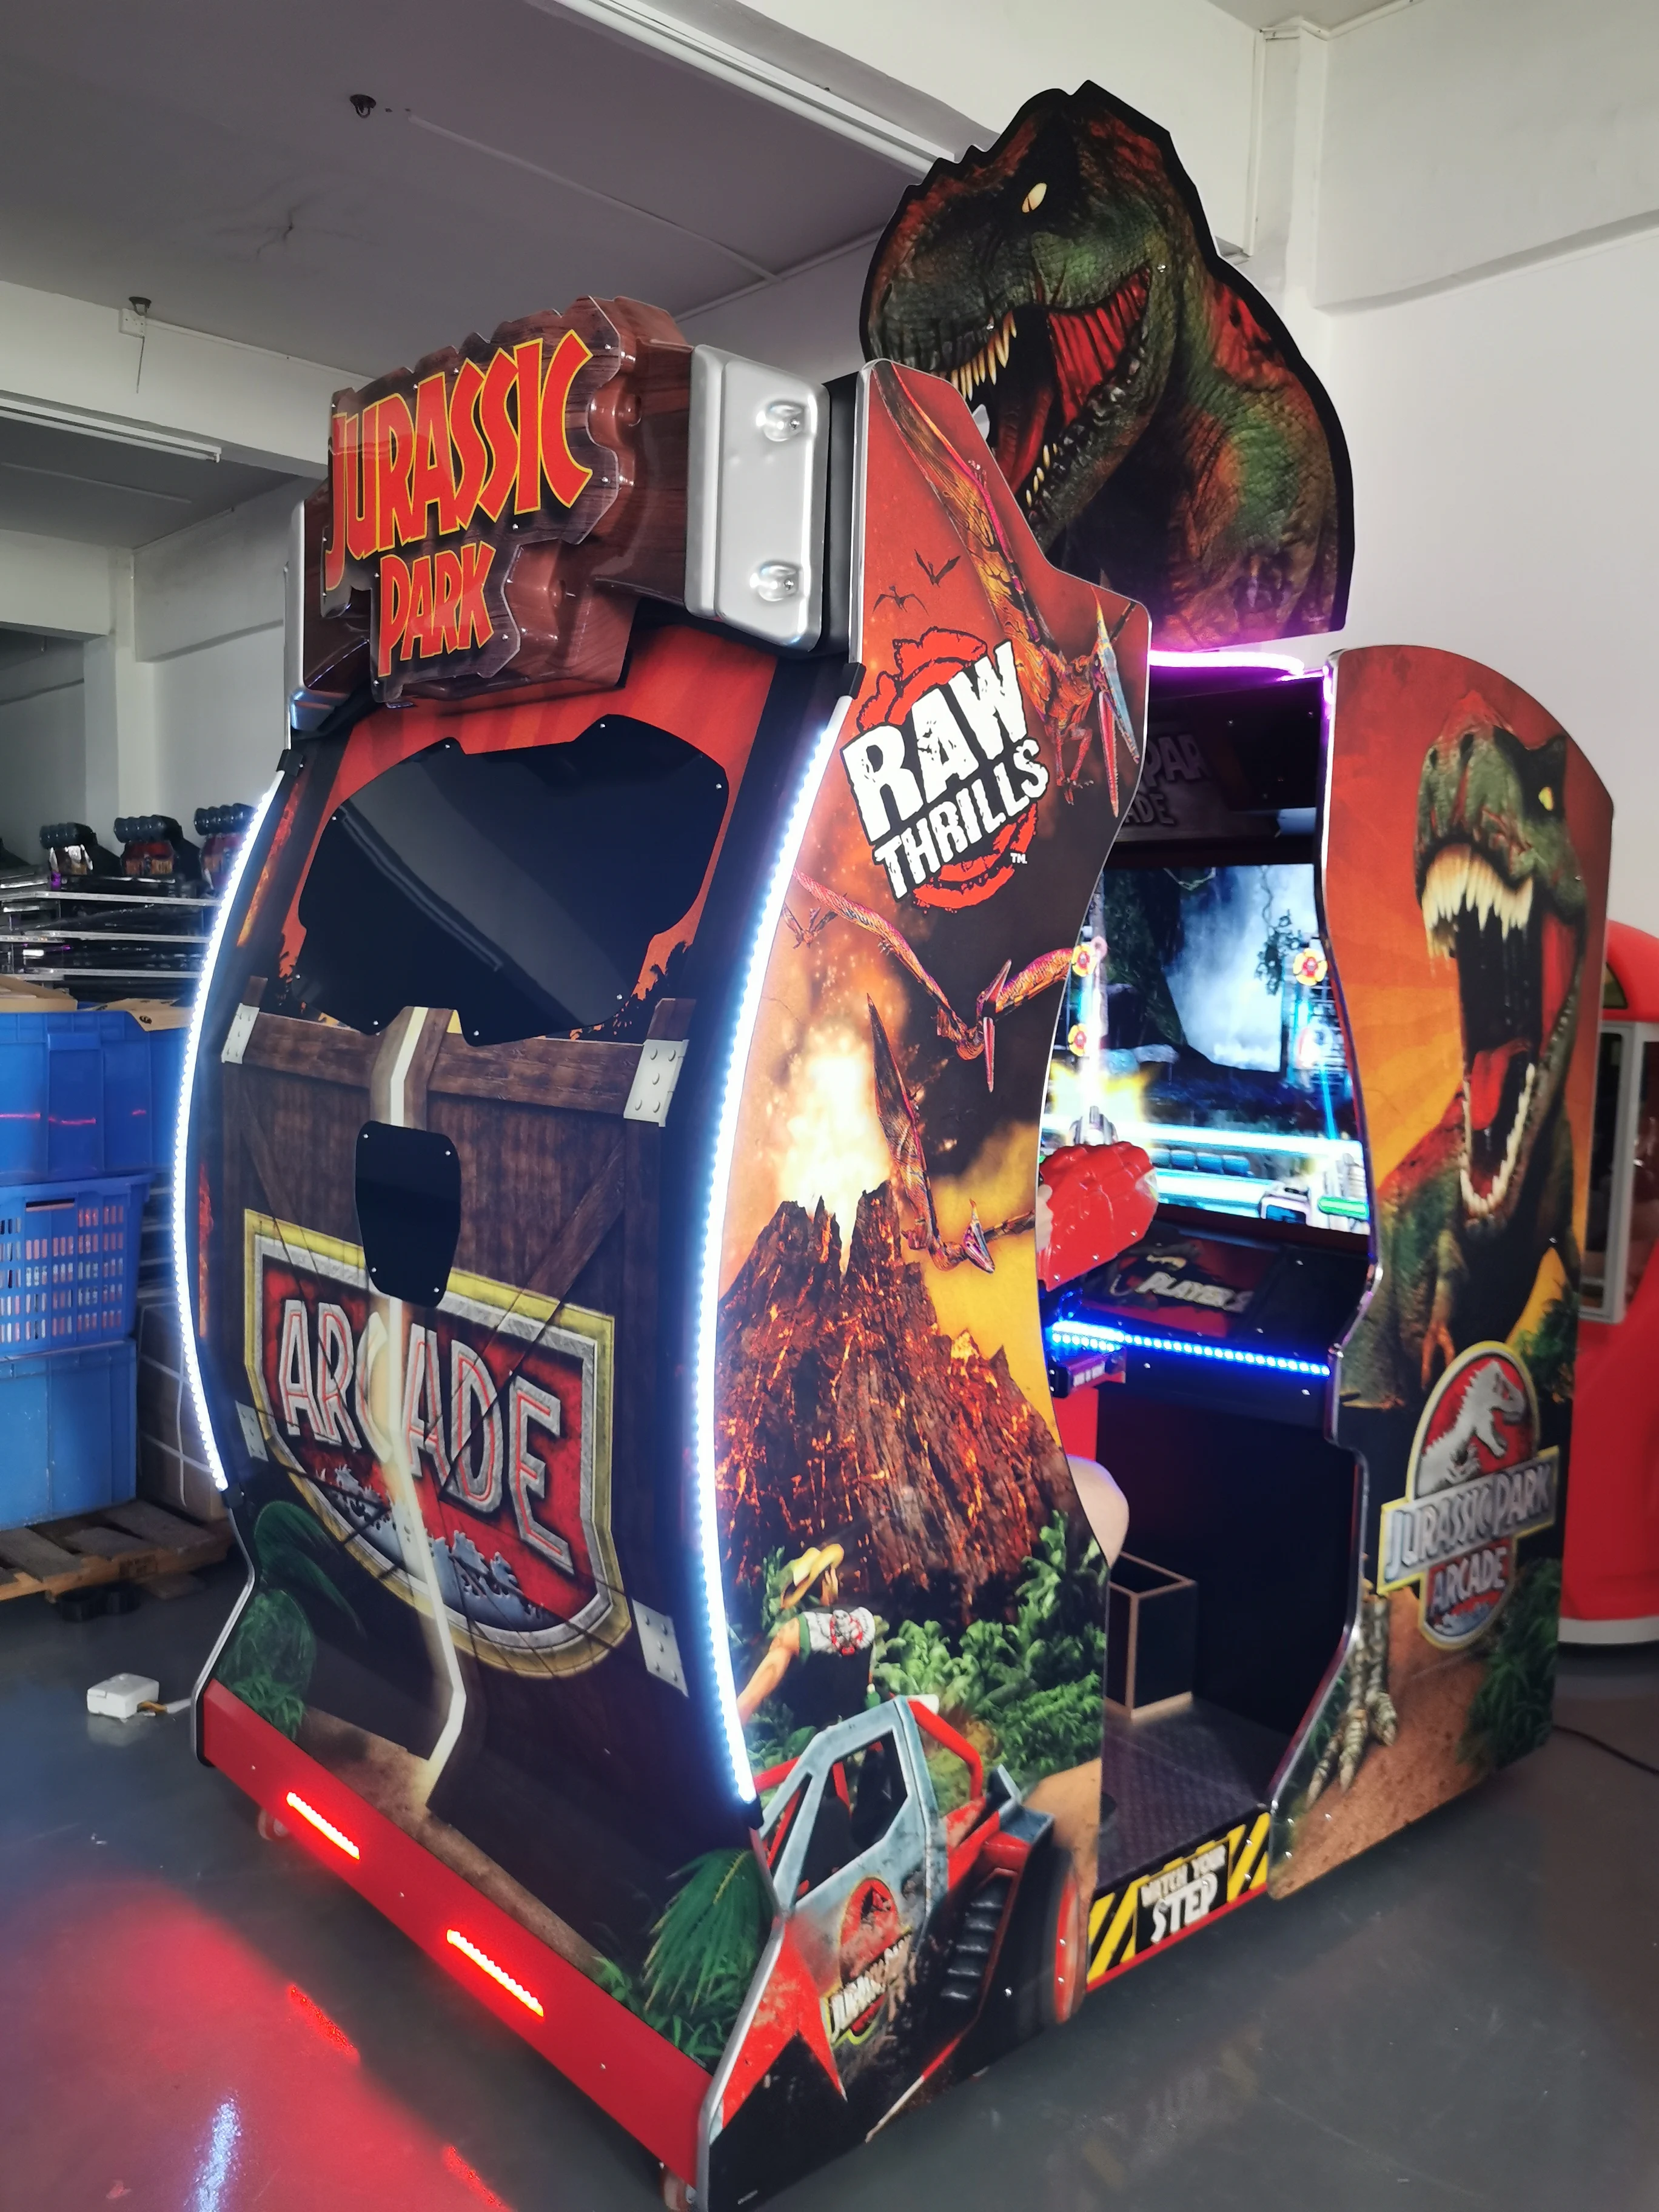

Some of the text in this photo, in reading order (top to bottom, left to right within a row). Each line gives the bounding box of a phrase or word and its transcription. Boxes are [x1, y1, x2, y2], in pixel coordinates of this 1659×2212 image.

[326, 329, 593, 591] JURASSIC
[378, 541, 496, 678] PARK
[842, 640, 1028, 842] RAW
[874, 739, 1048, 899] THRILLS
[279, 1299, 574, 1574] ARCADE
[1384, 1465, 1550, 1583] JURASSIC PARK
[1430, 1547, 1507, 1618] ARCADE
[1150, 1872, 1218, 1944] STEP
